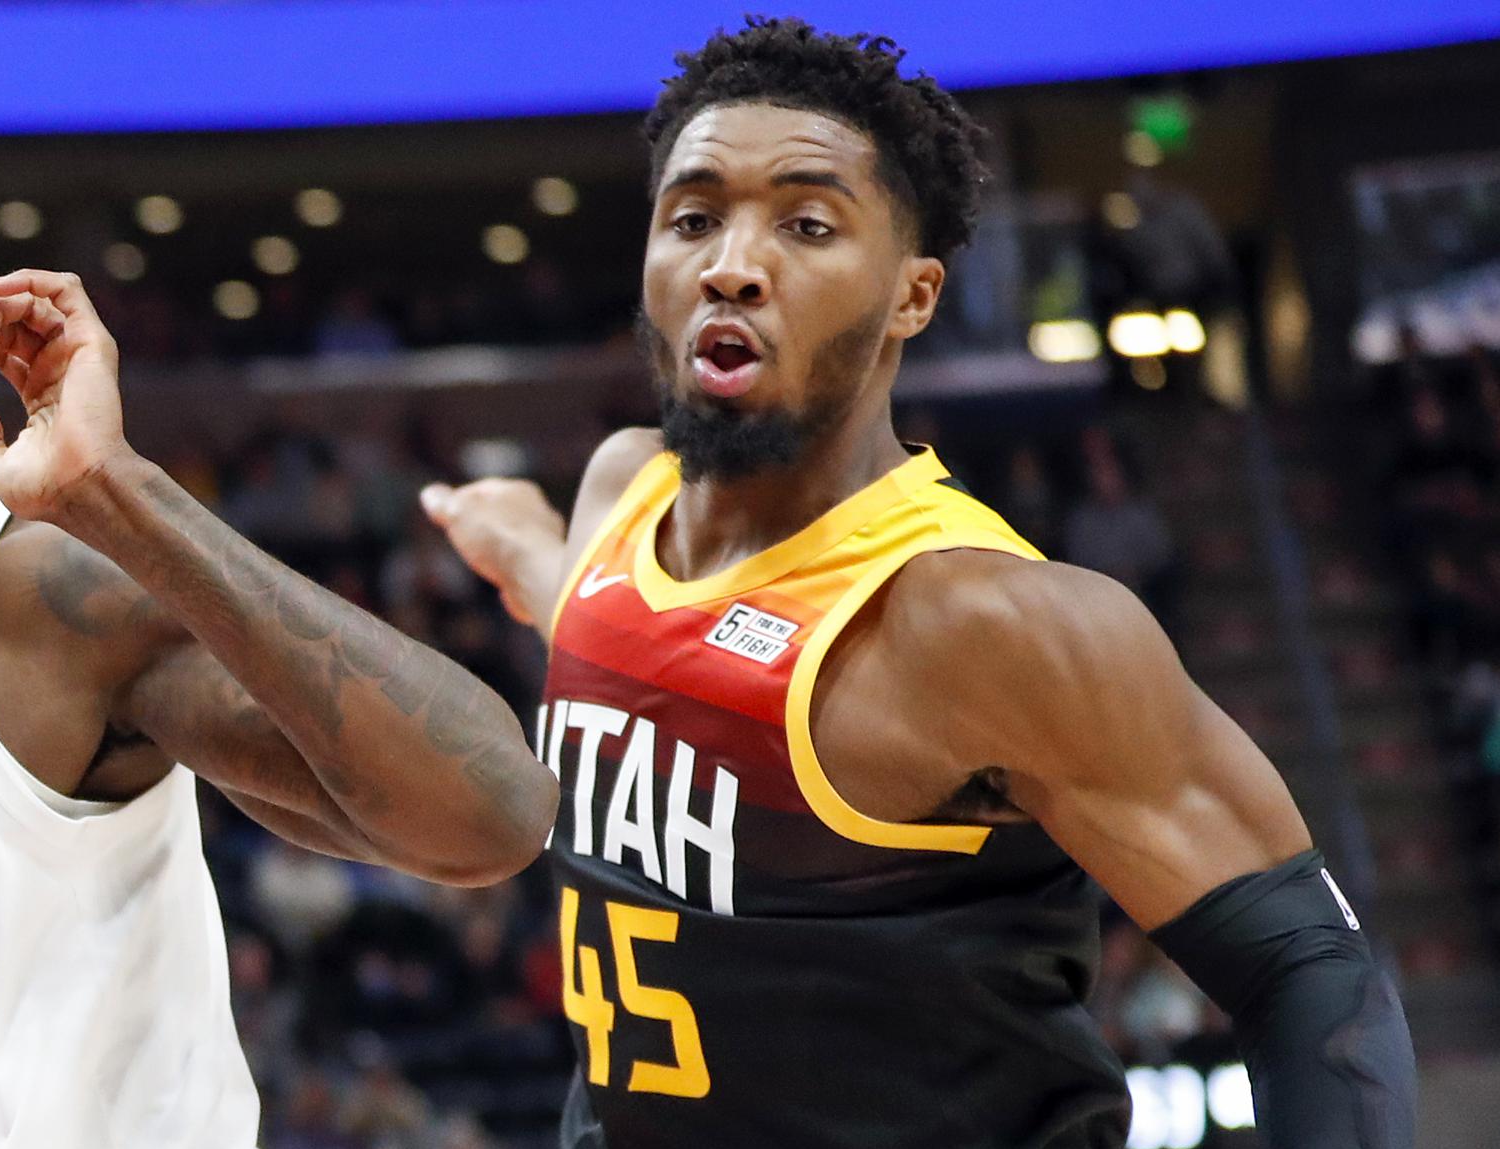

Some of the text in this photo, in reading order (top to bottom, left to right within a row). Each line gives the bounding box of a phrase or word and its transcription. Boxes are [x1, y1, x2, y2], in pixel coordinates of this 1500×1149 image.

[715, 608, 750, 642] 5
[734, 633, 781, 658] FIGHT
[560, 886, 711, 1099] 45
